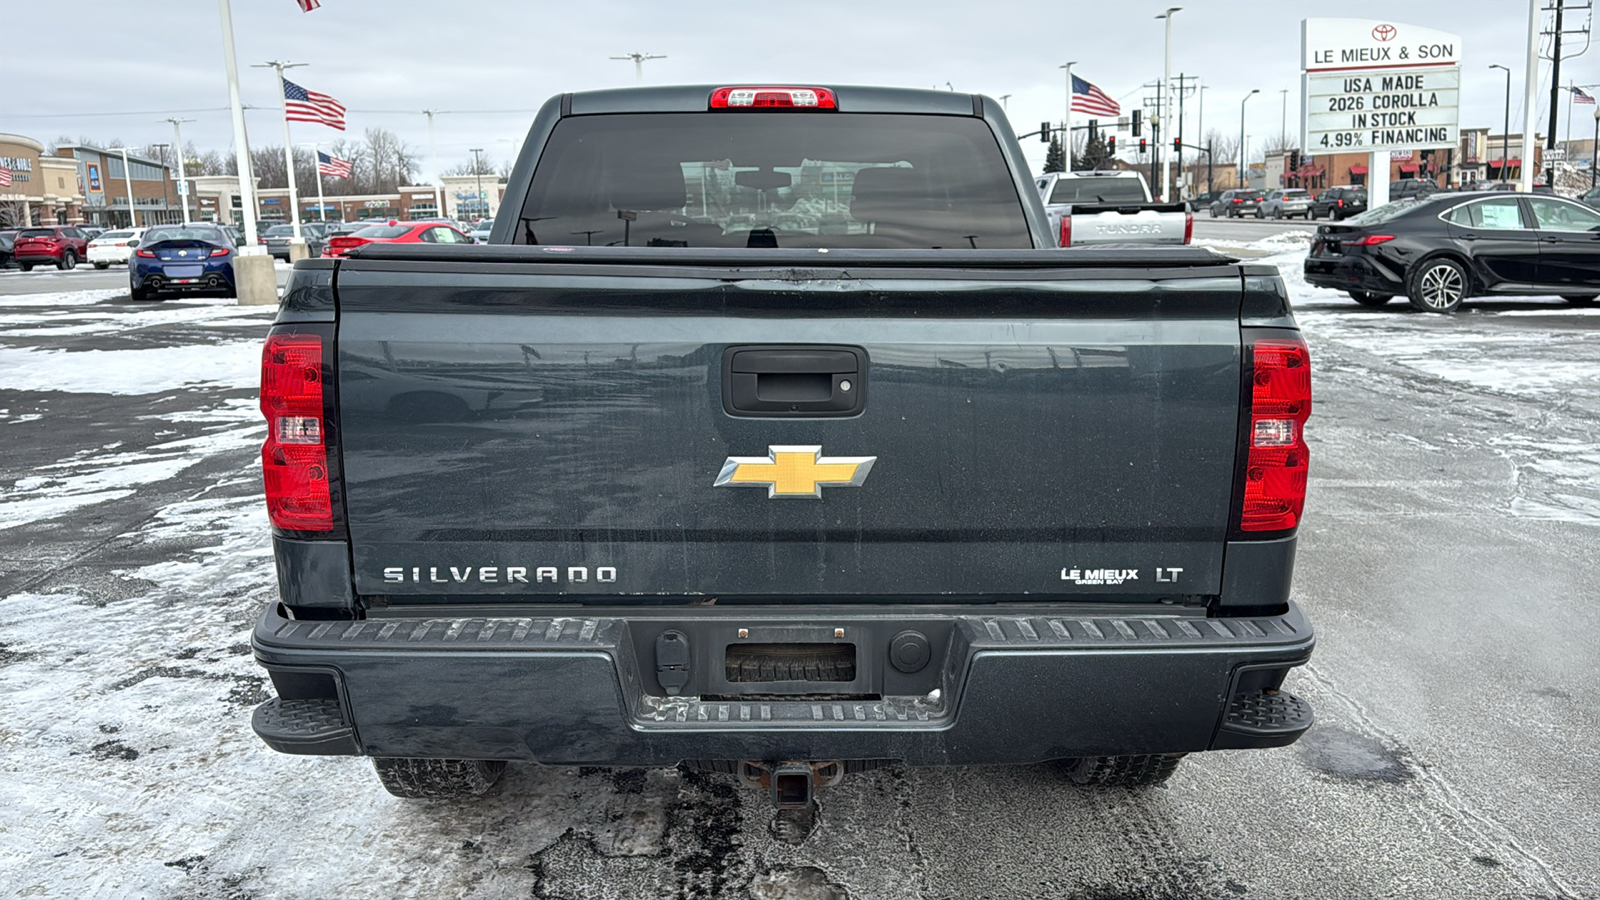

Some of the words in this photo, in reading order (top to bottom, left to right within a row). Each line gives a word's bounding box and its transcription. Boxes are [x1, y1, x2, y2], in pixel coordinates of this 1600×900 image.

[1314, 50, 1334, 64] LE
[1341, 47, 1391, 62] MIEUX
[1398, 46, 1410, 59] &
[1418, 44, 1453, 58] SON
[1343, 78, 1373, 93] USA
[1381, 75, 1424, 91] MADE
[1328, 96, 1364, 112] 2026
[1372, 92, 1438, 110] COROLLA
[1352, 113, 1367, 128] IN
[1371, 111, 1416, 127] STOCK
[1320, 132, 1363, 148] 4.99%
[1371, 128, 1447, 144] FINANCING
[1095, 224, 1162, 235] TUNDRA
[383, 566, 617, 583] SILVERADO
[1061, 569, 1081, 580] LE
[1085, 569, 1138, 580] MIEUX
[1156, 567, 1183, 582] LT
